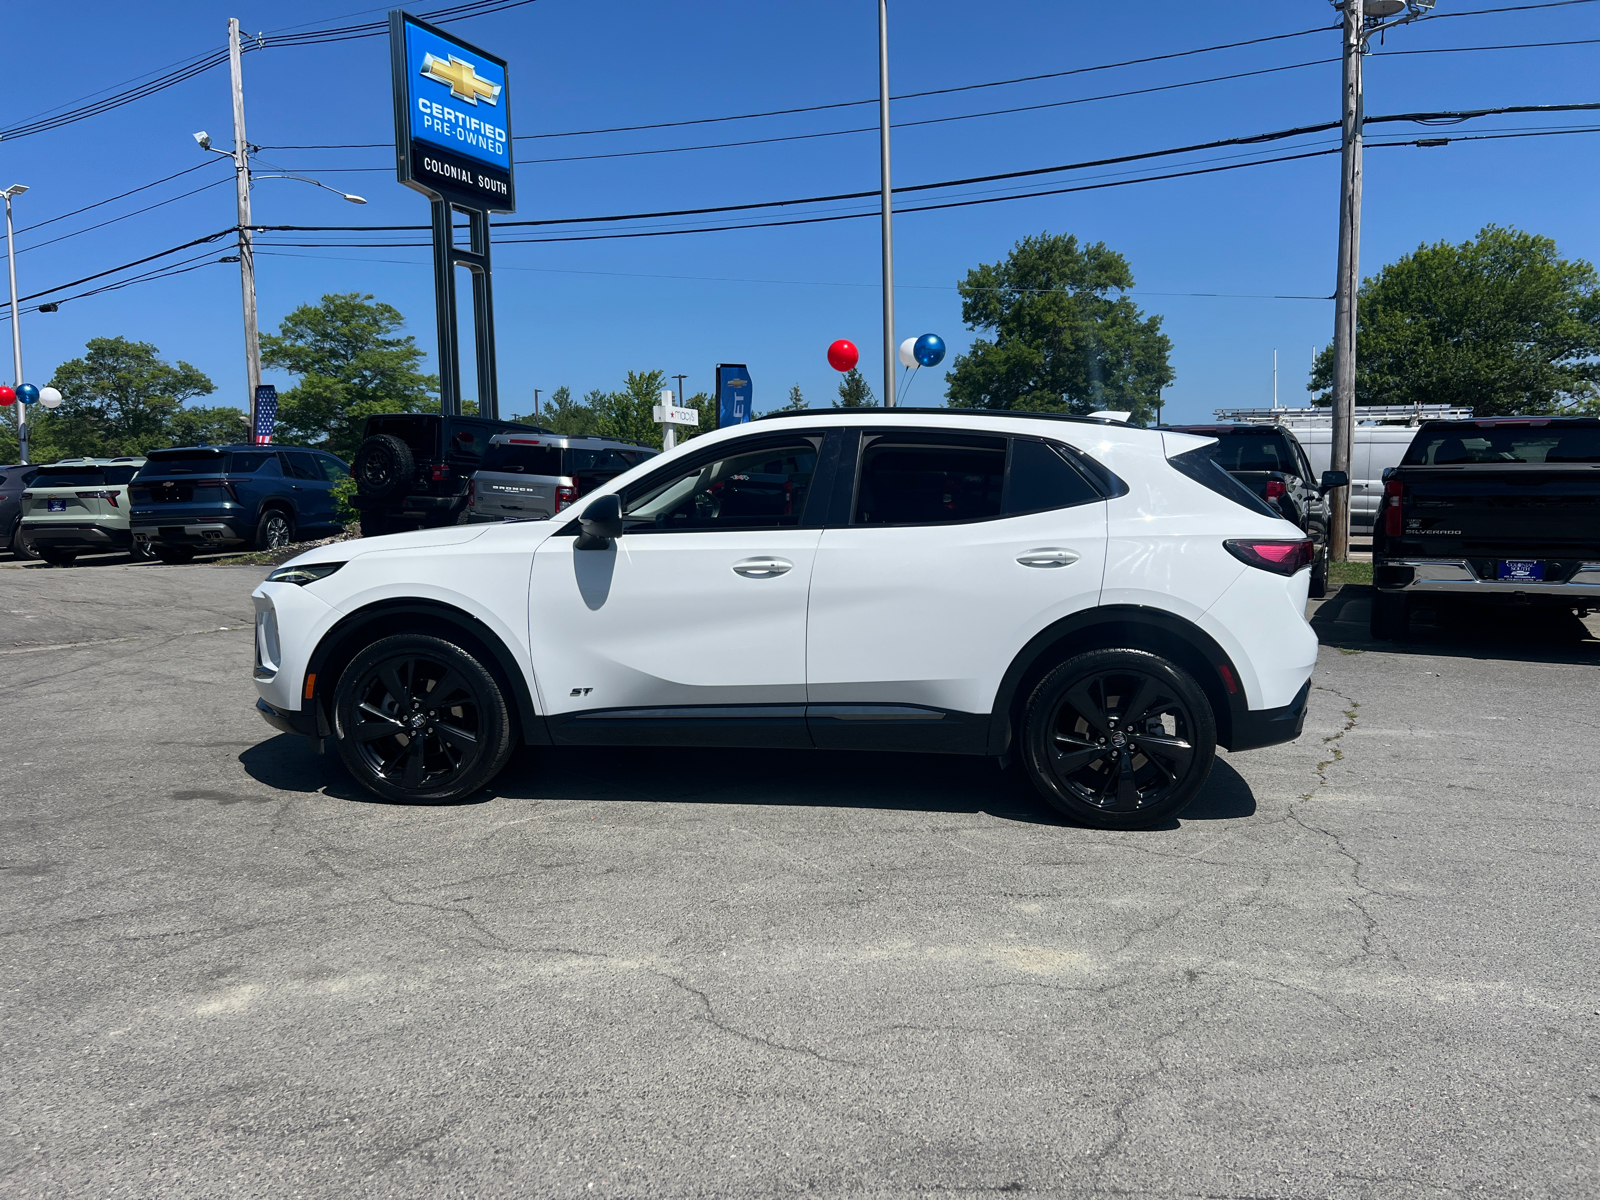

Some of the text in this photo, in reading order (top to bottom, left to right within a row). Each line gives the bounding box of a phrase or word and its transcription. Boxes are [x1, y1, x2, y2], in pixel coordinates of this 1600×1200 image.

[418, 97, 506, 143] CERTIFIED
[424, 115, 503, 155] PRE-OWNED
[424, 157, 507, 195] COLONIAL SOUTH
[674, 410, 695, 422] macy's
[733, 391, 744, 424] ET
[570, 687, 594, 697] ST
